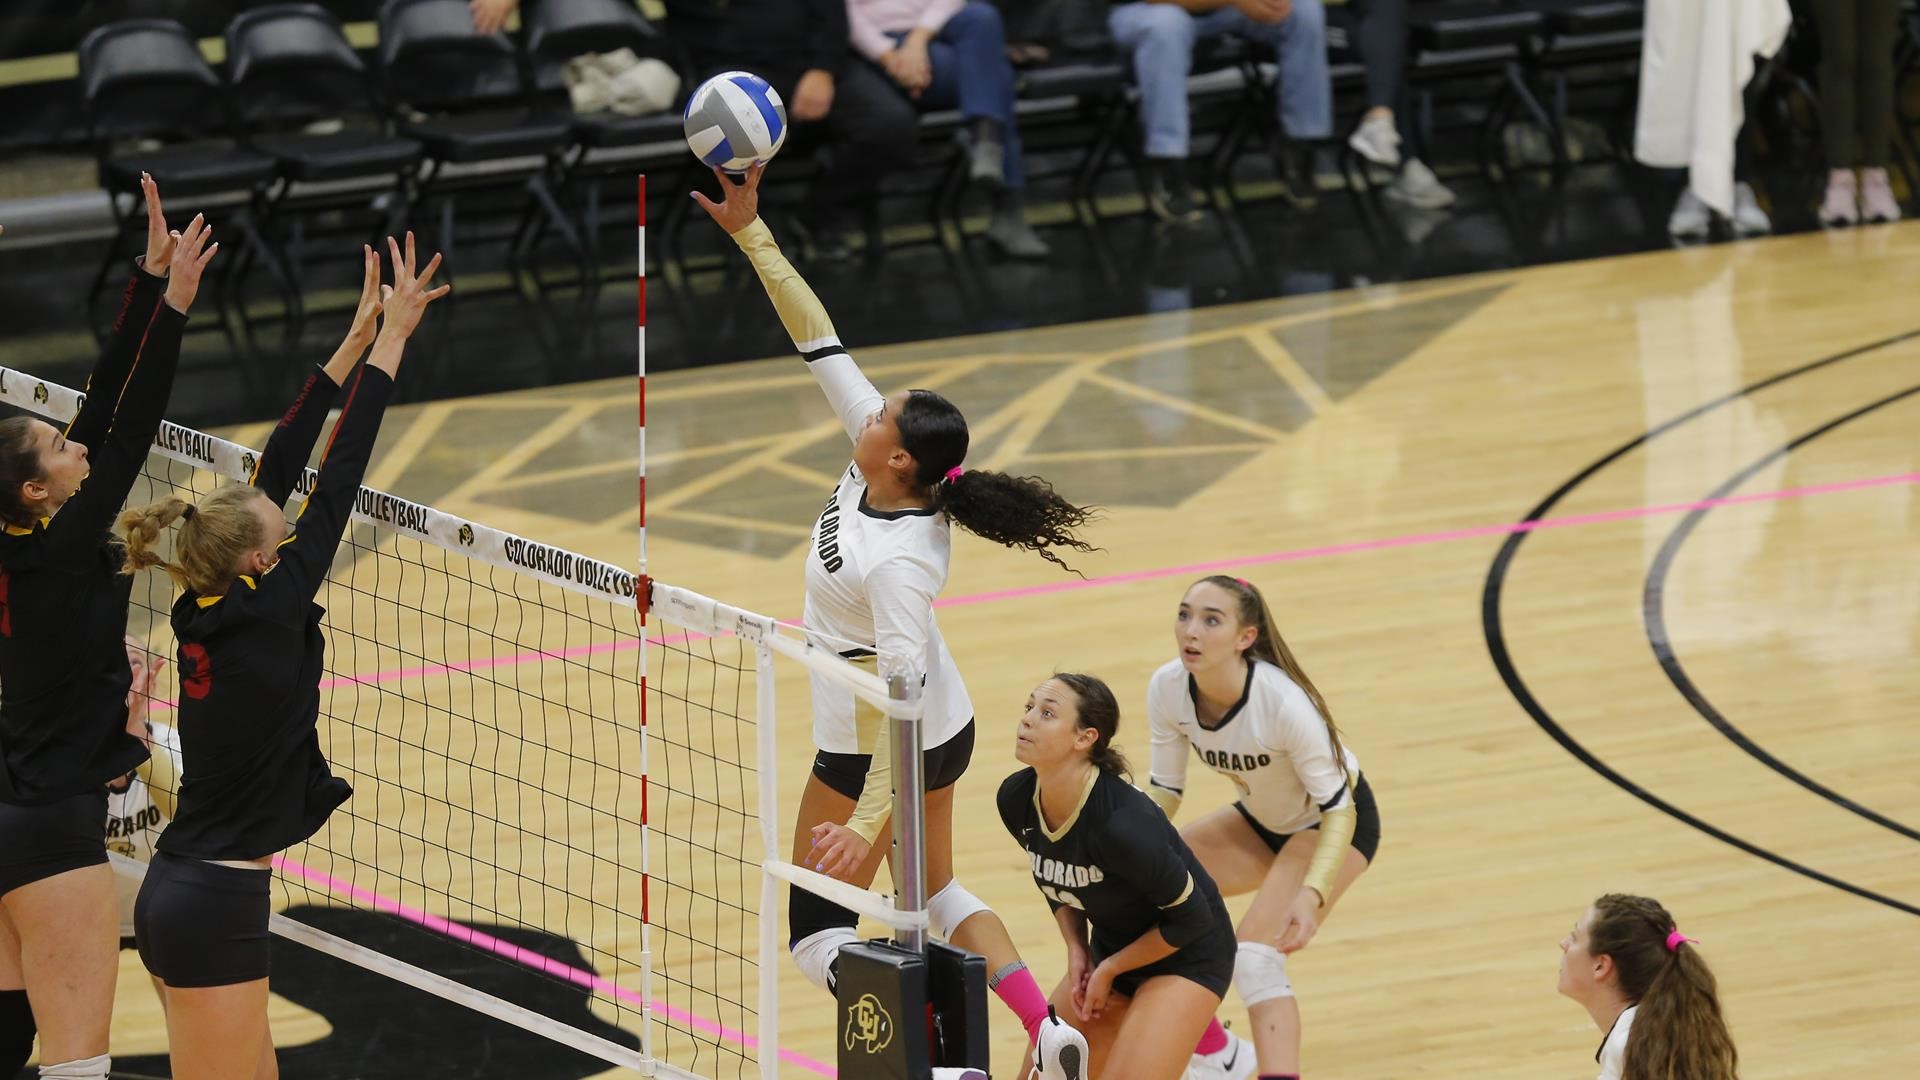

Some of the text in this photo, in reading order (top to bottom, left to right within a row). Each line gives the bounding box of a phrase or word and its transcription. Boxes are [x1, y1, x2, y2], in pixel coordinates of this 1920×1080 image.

[152, 423, 215, 464] LLEYBALL
[355, 487, 429, 535] VOLLEYBALL
[818, 484, 844, 574] OLORADO
[504, 536, 654, 607] COLORADO VOLLEYBA
[181, 643, 211, 700] 3
[107, 805, 160, 838] RADO
[1027, 845, 1105, 888] OLORADO
